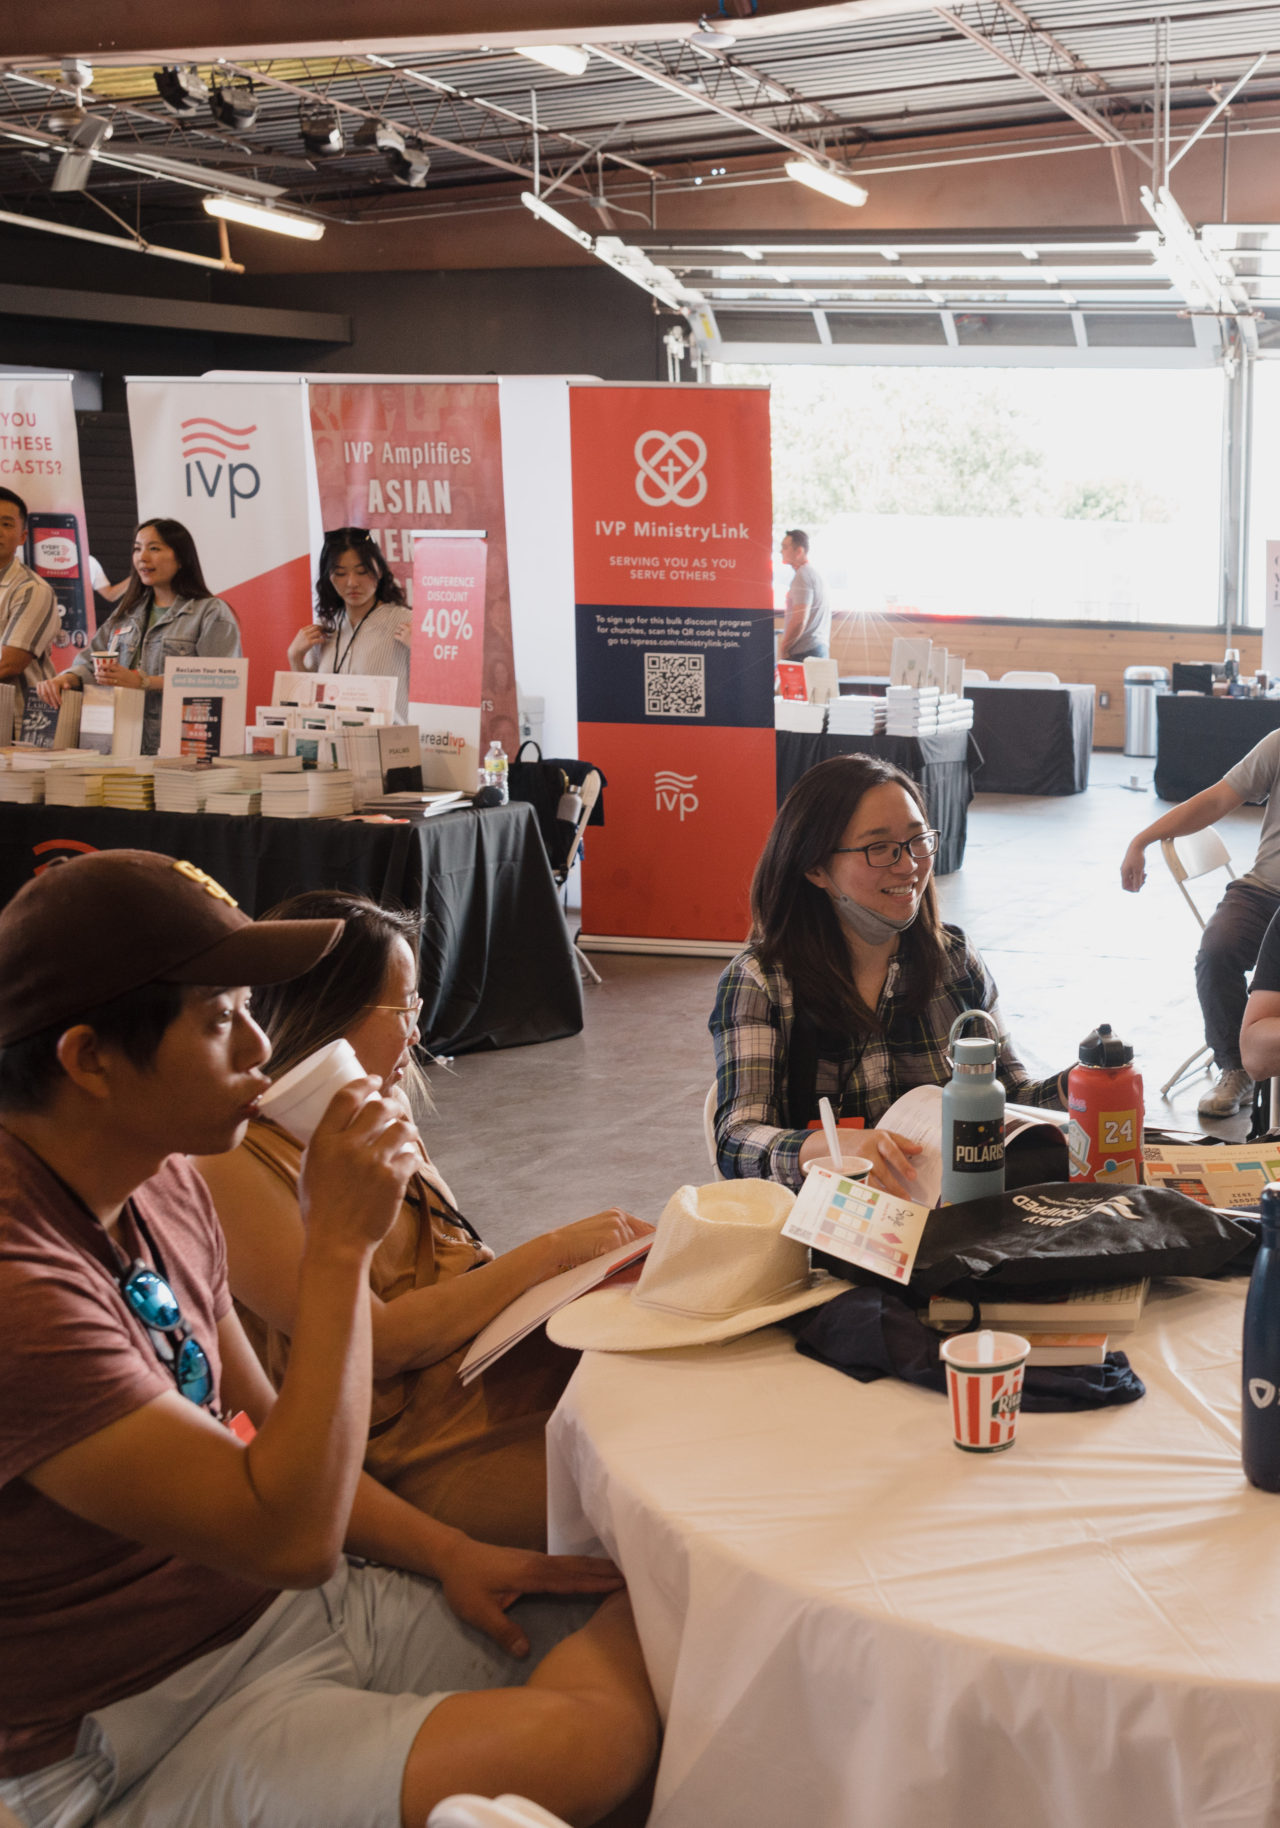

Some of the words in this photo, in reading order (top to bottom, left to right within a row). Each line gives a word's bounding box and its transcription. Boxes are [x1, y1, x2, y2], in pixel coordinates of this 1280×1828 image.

[0, 412, 36, 427] YOU
[0, 435, 53, 451] THESE
[344, 441, 373, 464] IVP
[382, 441, 471, 469] Amplifies
[0, 459, 62, 475] CASTS?
[185, 460, 261, 519] ivp
[368, 479, 452, 514] ASIAN
[595, 520, 626, 536] IVP
[634, 521, 750, 543] MinistryLink
[609, 556, 660, 567] SERVING
[664, 557, 688, 567] YOU
[692, 558, 707, 568] AS
[711, 558, 736, 568] YOU
[422, 576, 475, 587] CONFERENCE
[630, 569, 666, 580] SERVE
[669, 570, 716, 581] OTHERS
[427, 590, 469, 602] DISCOUNT
[421, 608, 473, 640] 40%
[595, 615, 605, 623] To
[607, 616, 623, 625] sign
[625, 617, 634, 625] up
[637, 616, 648, 624] for
[650, 616, 664, 625] this
[666, 617, 682, 625] bulk
[684, 618, 717, 626] discount
[719, 620, 752, 628] program
[610, 626, 646, 635] churches,
[682, 628, 694, 636] QR
[696, 628, 715, 636] code
[717, 629, 740, 637] below
[608, 638, 618, 646] go
[620, 637, 629, 645] to
[433, 644, 459, 660] OFF
[421, 731, 466, 756] #readivp
[656, 791, 699, 821] ivp
[1104, 1119, 1133, 1144] 24
[956, 1143, 1004, 1163] POLARIS
